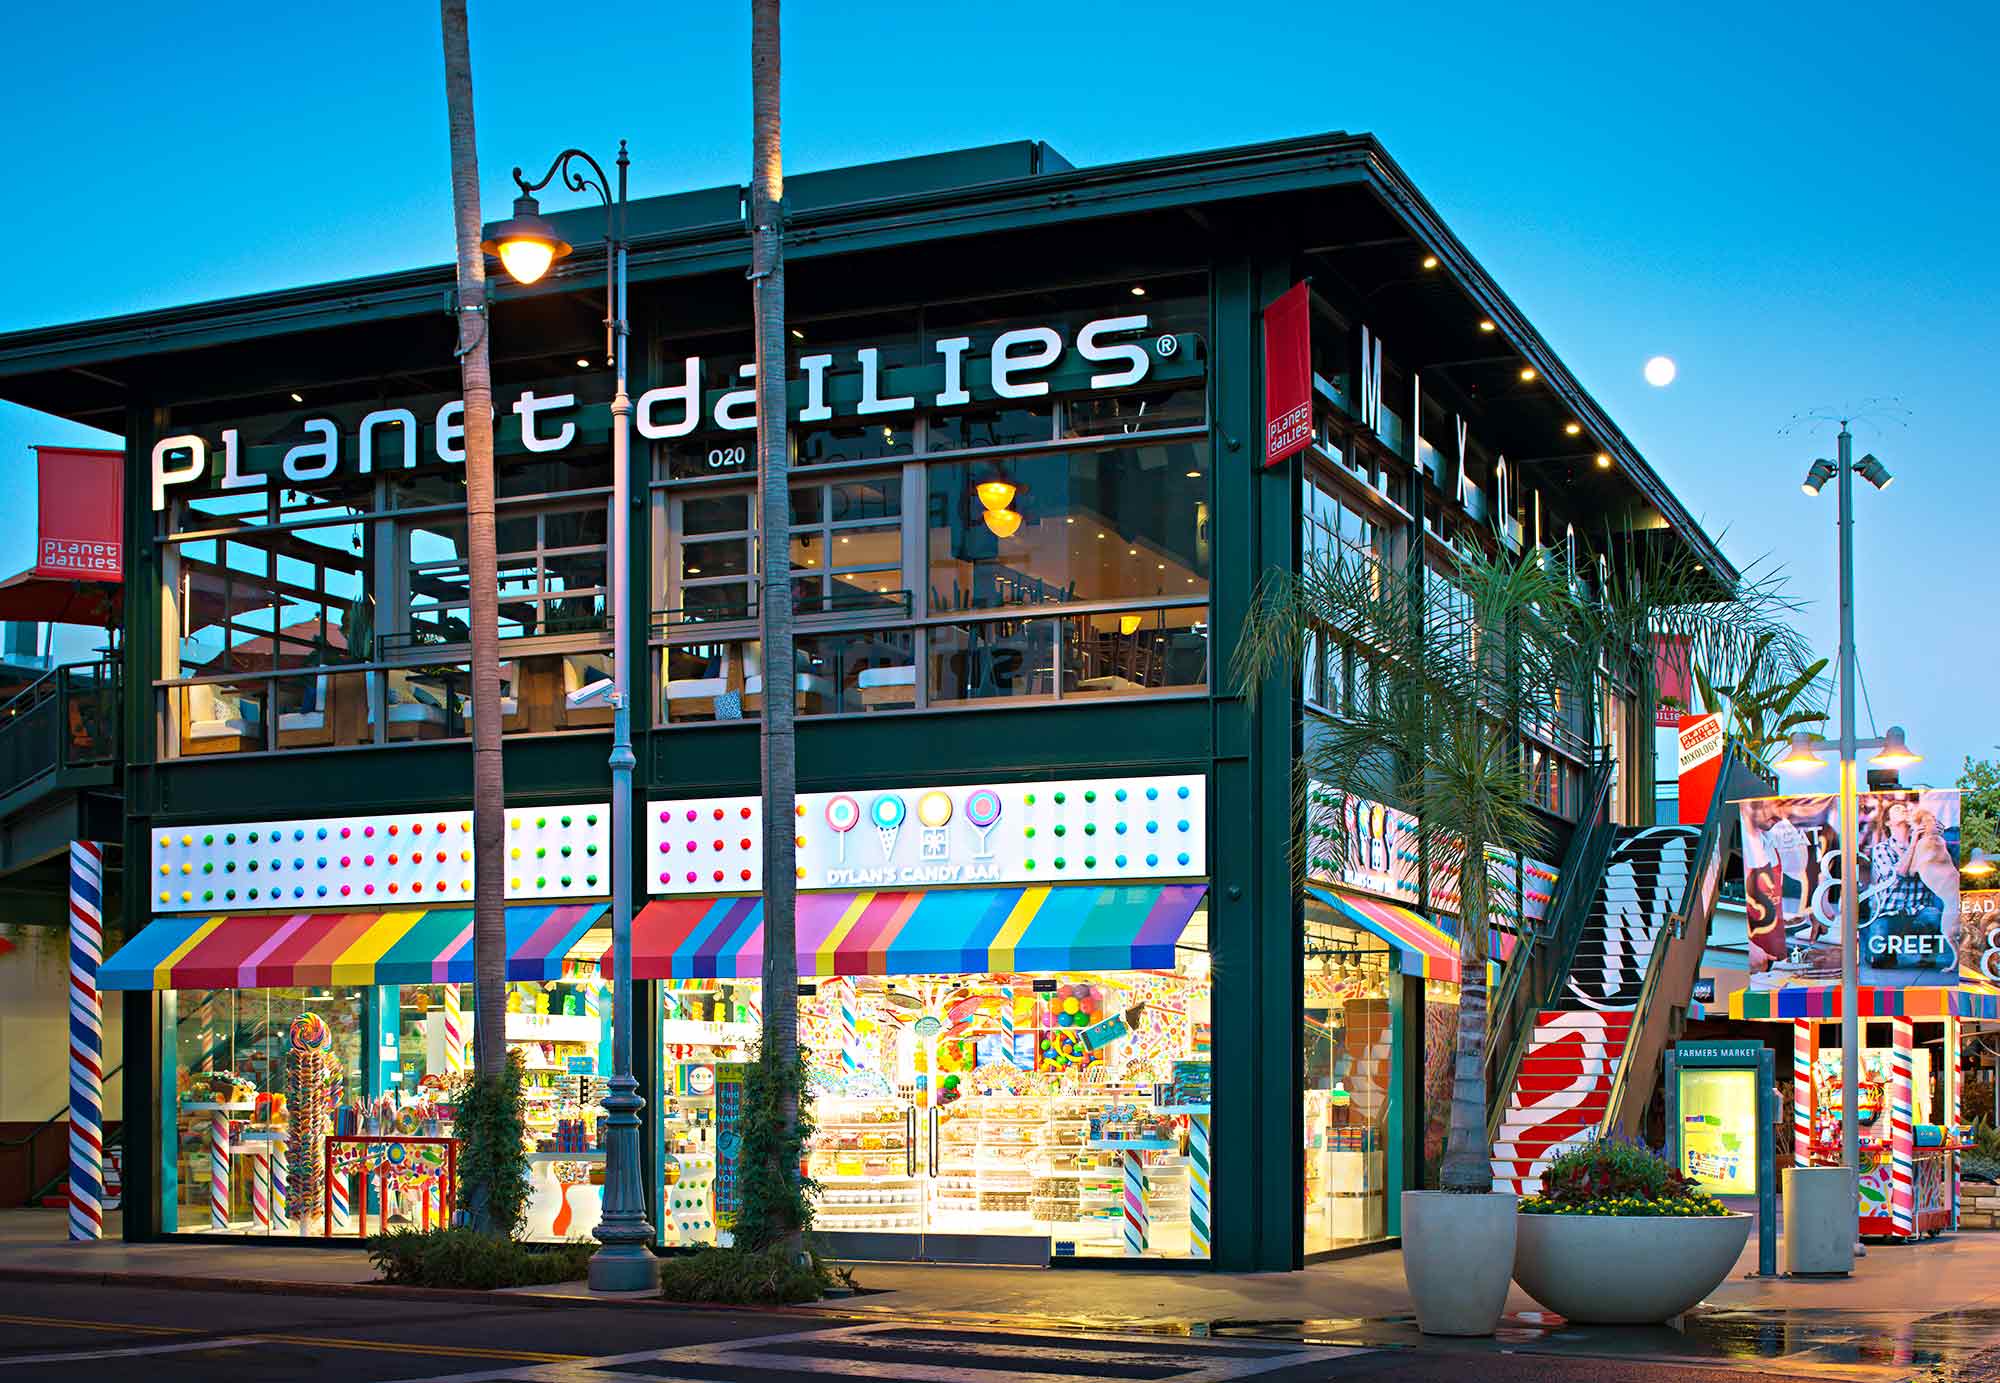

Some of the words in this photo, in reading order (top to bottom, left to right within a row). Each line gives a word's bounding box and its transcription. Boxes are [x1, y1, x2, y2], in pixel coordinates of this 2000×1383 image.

[826, 868, 897, 885] DYLAN'S
[900, 865, 962, 882] CANDY
[965, 864, 1001, 881] BAR
[1960, 899, 1996, 914] EAD
[1868, 934, 1946, 955] GREET
[1679, 1048, 1718, 1057] FARMERS
[1720, 1048, 1755, 1057] MARKET
